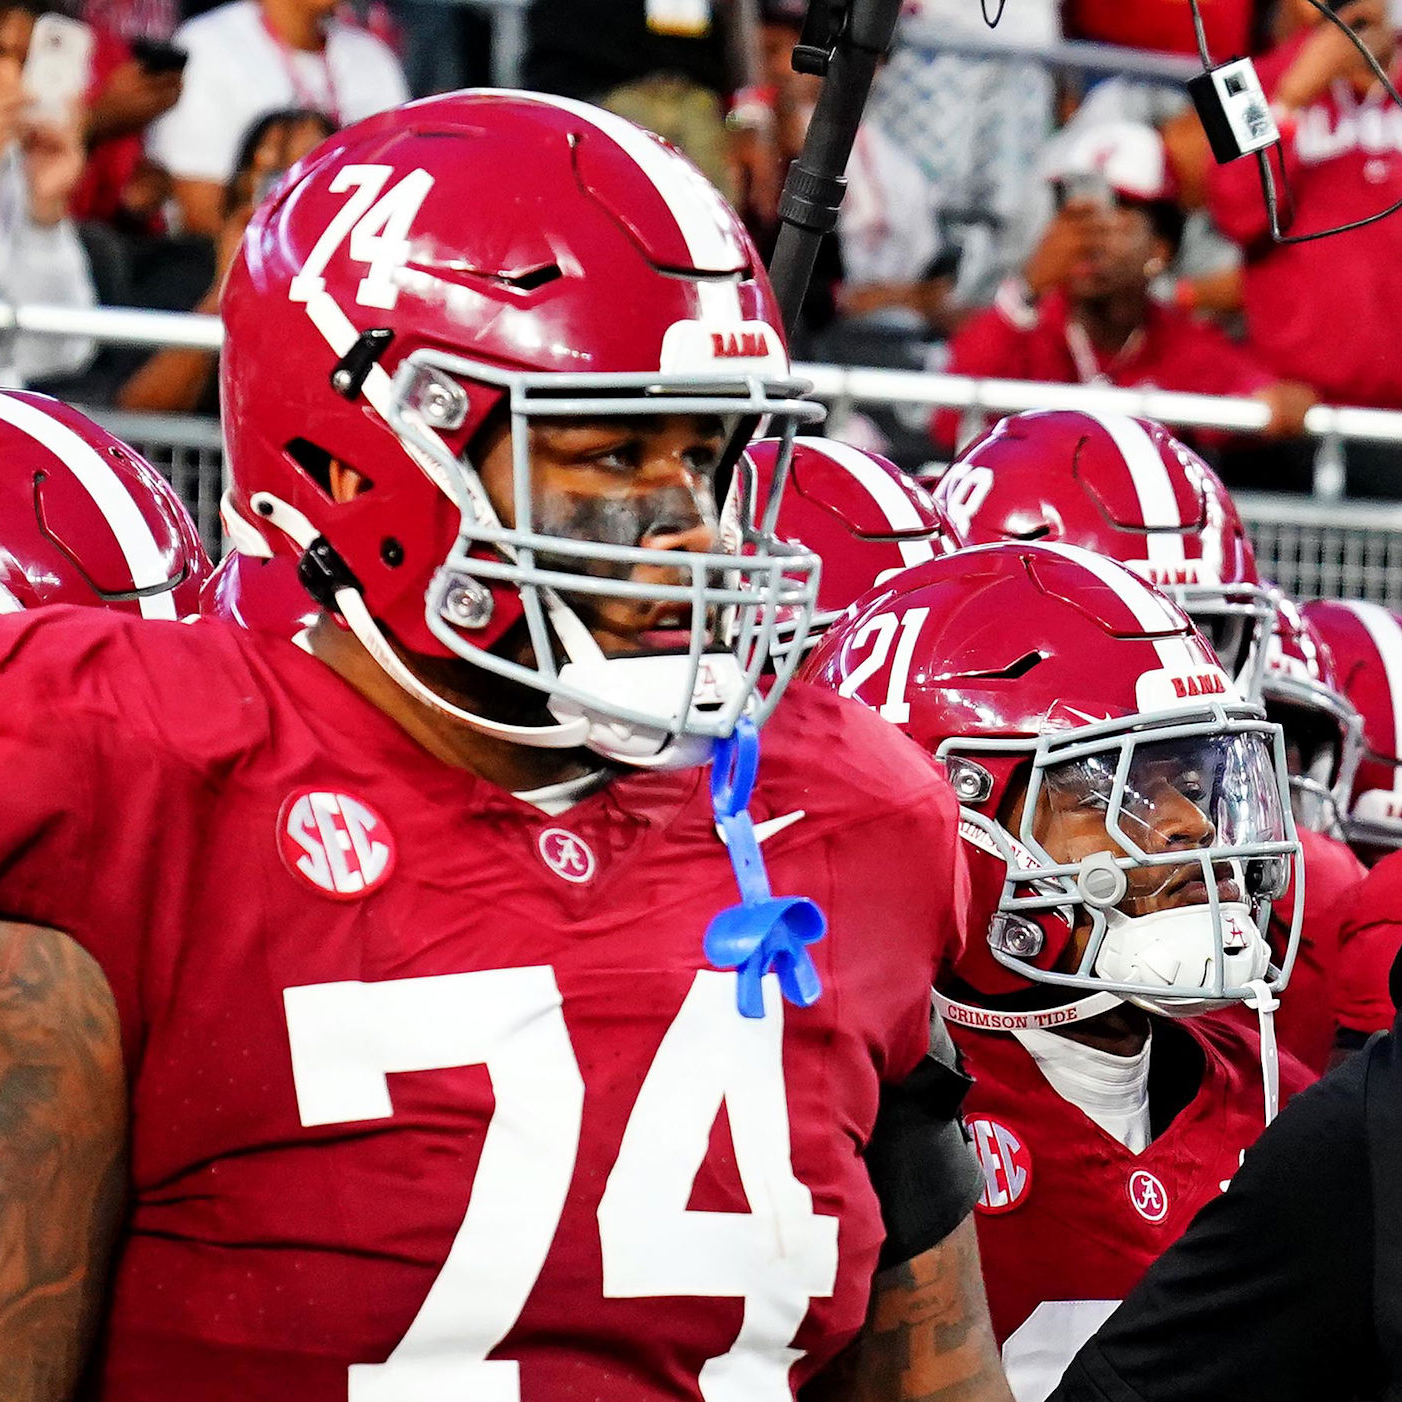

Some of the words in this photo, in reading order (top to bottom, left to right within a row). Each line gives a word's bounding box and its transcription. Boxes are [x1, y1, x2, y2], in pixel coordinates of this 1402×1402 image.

[288, 163, 435, 310] 74
[710, 331, 770, 358] BAMA
[1148, 567, 1200, 586] BAMA
[838, 606, 930, 724] 21
[1170, 673, 1228, 699] BAMA
[286, 791, 392, 894] SEC
[948, 1005, 1028, 1029] CRIMSON
[1034, 1006, 1078, 1027] TIDE
[968, 1119, 1028, 1208] EC
